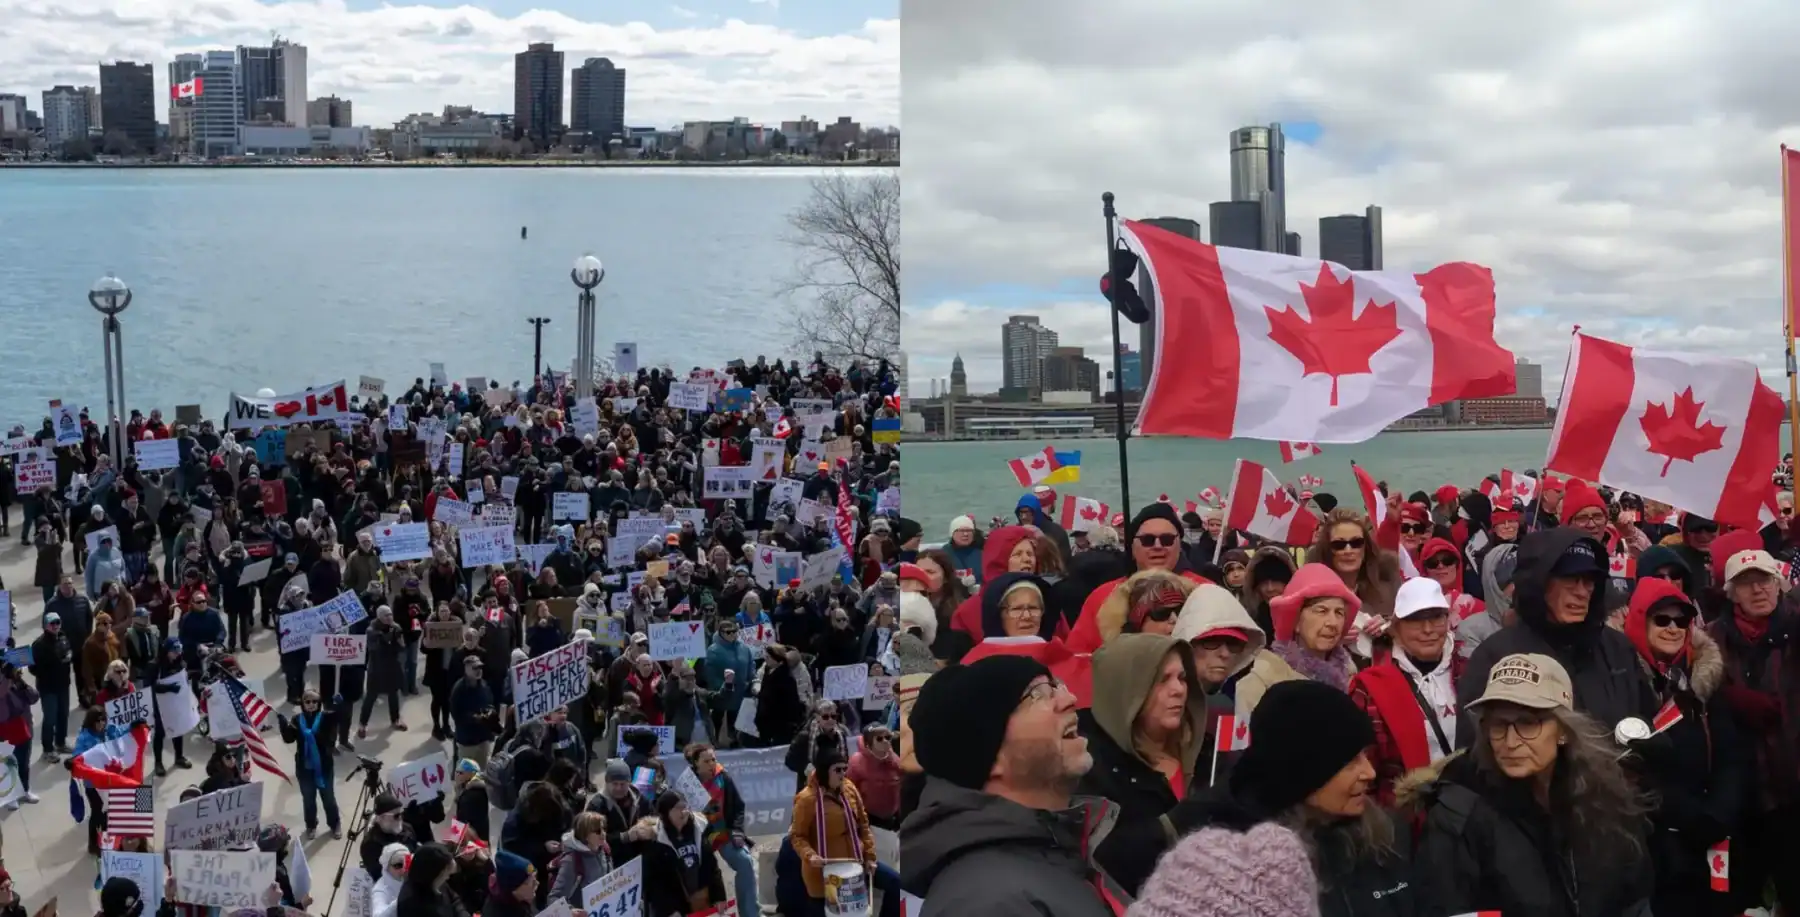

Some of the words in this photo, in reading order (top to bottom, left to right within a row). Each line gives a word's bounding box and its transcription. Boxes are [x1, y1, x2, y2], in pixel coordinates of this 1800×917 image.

[234, 399, 270, 421] WE
[324, 636, 354, 647] FIRE
[516, 642, 586, 684] FASCISM
[1496, 668, 1533, 680] CANADA
[527, 676, 548, 697] IS
[551, 658, 585, 685] HERE
[113, 692, 144, 714] STOP
[517, 688, 556, 722] FIGHT
[558, 673, 587, 704] BACK
[110, 705, 149, 725] TRUMPS
[392, 773, 418, 800] WE
[197, 789, 244, 818] EVIL
[589, 872, 637, 906] DEMOCRACY
[602, 867, 625, 886] SAVE
[616, 884, 640, 916] 47
